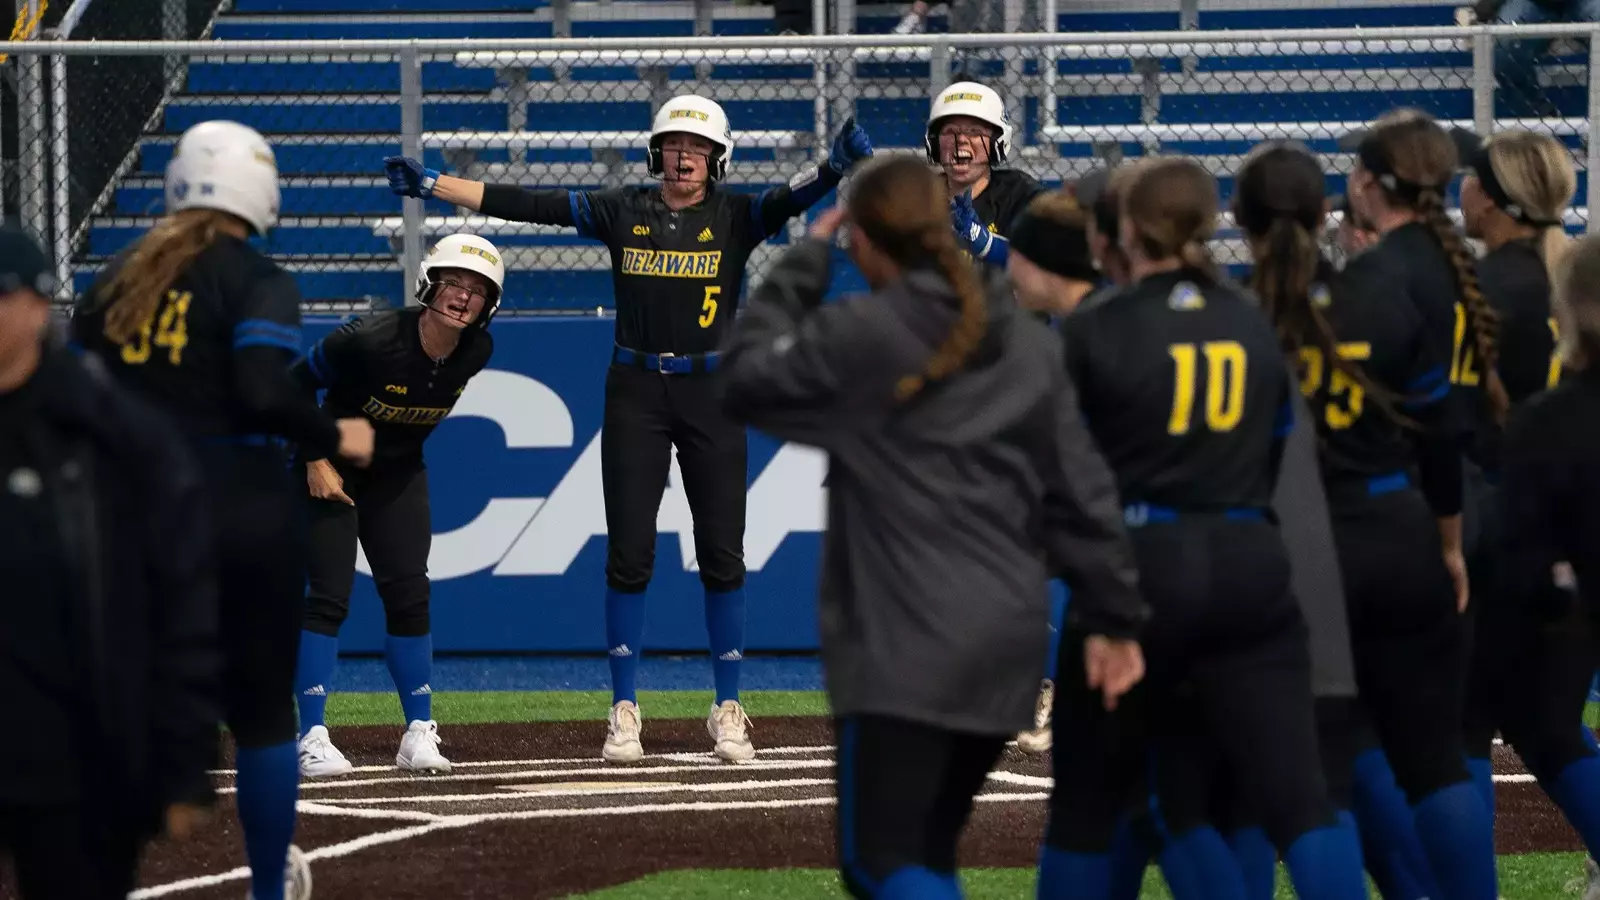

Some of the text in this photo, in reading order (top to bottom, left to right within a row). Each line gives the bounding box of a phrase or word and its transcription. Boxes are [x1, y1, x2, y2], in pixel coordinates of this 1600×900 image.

[622, 247, 721, 278] DELAWARE
[699, 285, 721, 328] 5
[1167, 341, 1247, 436] 10
